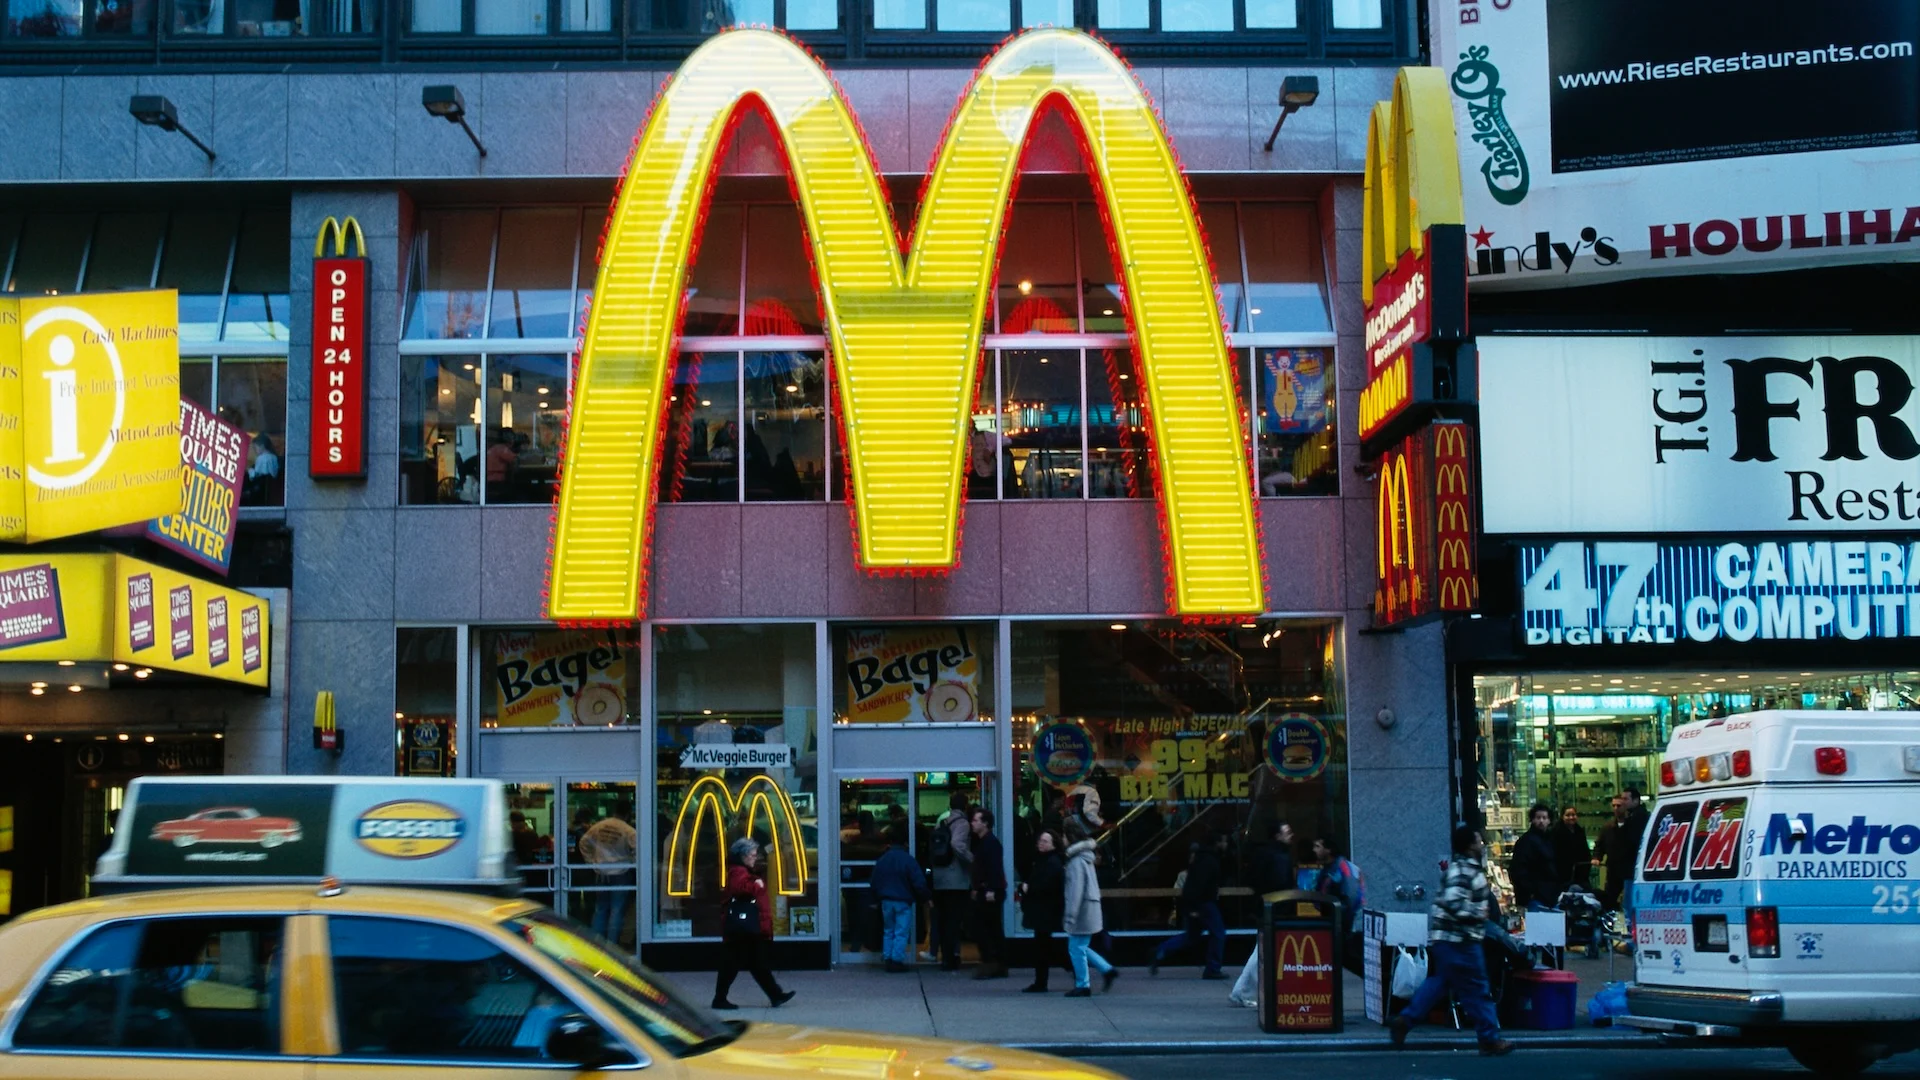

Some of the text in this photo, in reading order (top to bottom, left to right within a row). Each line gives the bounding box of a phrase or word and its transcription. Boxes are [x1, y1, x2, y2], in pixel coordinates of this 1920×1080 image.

[1558, 40, 1913, 90] www.RieseRestaurants.com
[1468, 97, 1530, 206] Charley
[1365, 272, 1425, 351] McDonald's
[83, 324, 178, 345] Cash Machines
[323, 269, 351, 463] OPEN 24 HOURS
[59, 373, 179, 398] Free Internet Access
[109, 421, 181, 444] MetroCards
[36, 476, 119, 503] International
[157, 513, 226, 562] CENTER
[1527, 627, 1675, 646] DIGITAL
[497, 628, 623, 705] Bagel
[848, 626, 974, 703] Bagel
[856, 688, 912, 714] SANDWICHES
[1114, 714, 1248, 735] Late Night SPECIAL
[1678, 721, 1753, 740] KEEP BACK
[749, 749, 788, 765] Burger
[1120, 773, 1249, 800] BIG MAC
[359, 818, 462, 839] FOSSIL
[1759, 813, 1920, 857] Metro
[1777, 860, 1908, 878] PARAMEDICS
[1651, 882, 1724, 905] Metro Care
[1639, 909, 1684, 922] PARAMEDICS
[1639, 928, 1655, 945] 251
[1664, 928, 1687, 945] 8888
[1283, 963, 1333, 972] McDonald's
[1278, 994, 1332, 1005] BROADWAY
[1308, 1014, 1333, 1025] Street
